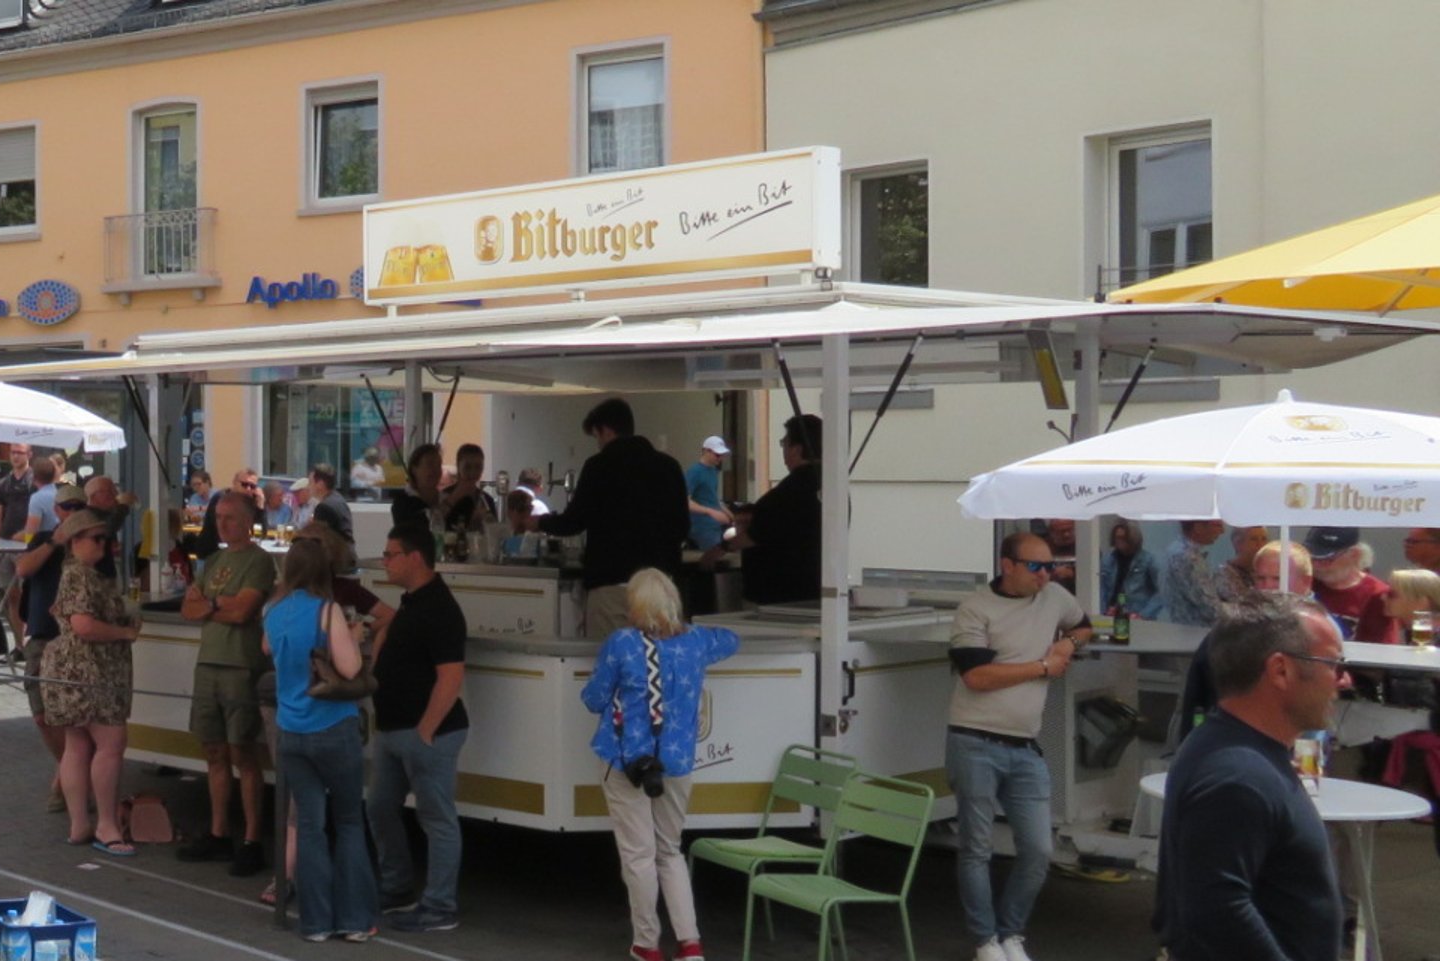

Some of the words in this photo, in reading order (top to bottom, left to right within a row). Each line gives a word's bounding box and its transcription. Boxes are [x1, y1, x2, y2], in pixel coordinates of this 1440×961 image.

[678, 210, 720, 235] Bitte
[726, 203, 754, 218] ein
[758, 179, 793, 206] Bit
[510, 206, 660, 263] Bitburger
[245, 271, 340, 310] Apollo
[1062, 483, 1094, 501] Bitte
[1120, 472, 1149, 489] Bit
[1312, 482, 1426, 517] Bitburger
[706, 742, 734, 760] Bit
